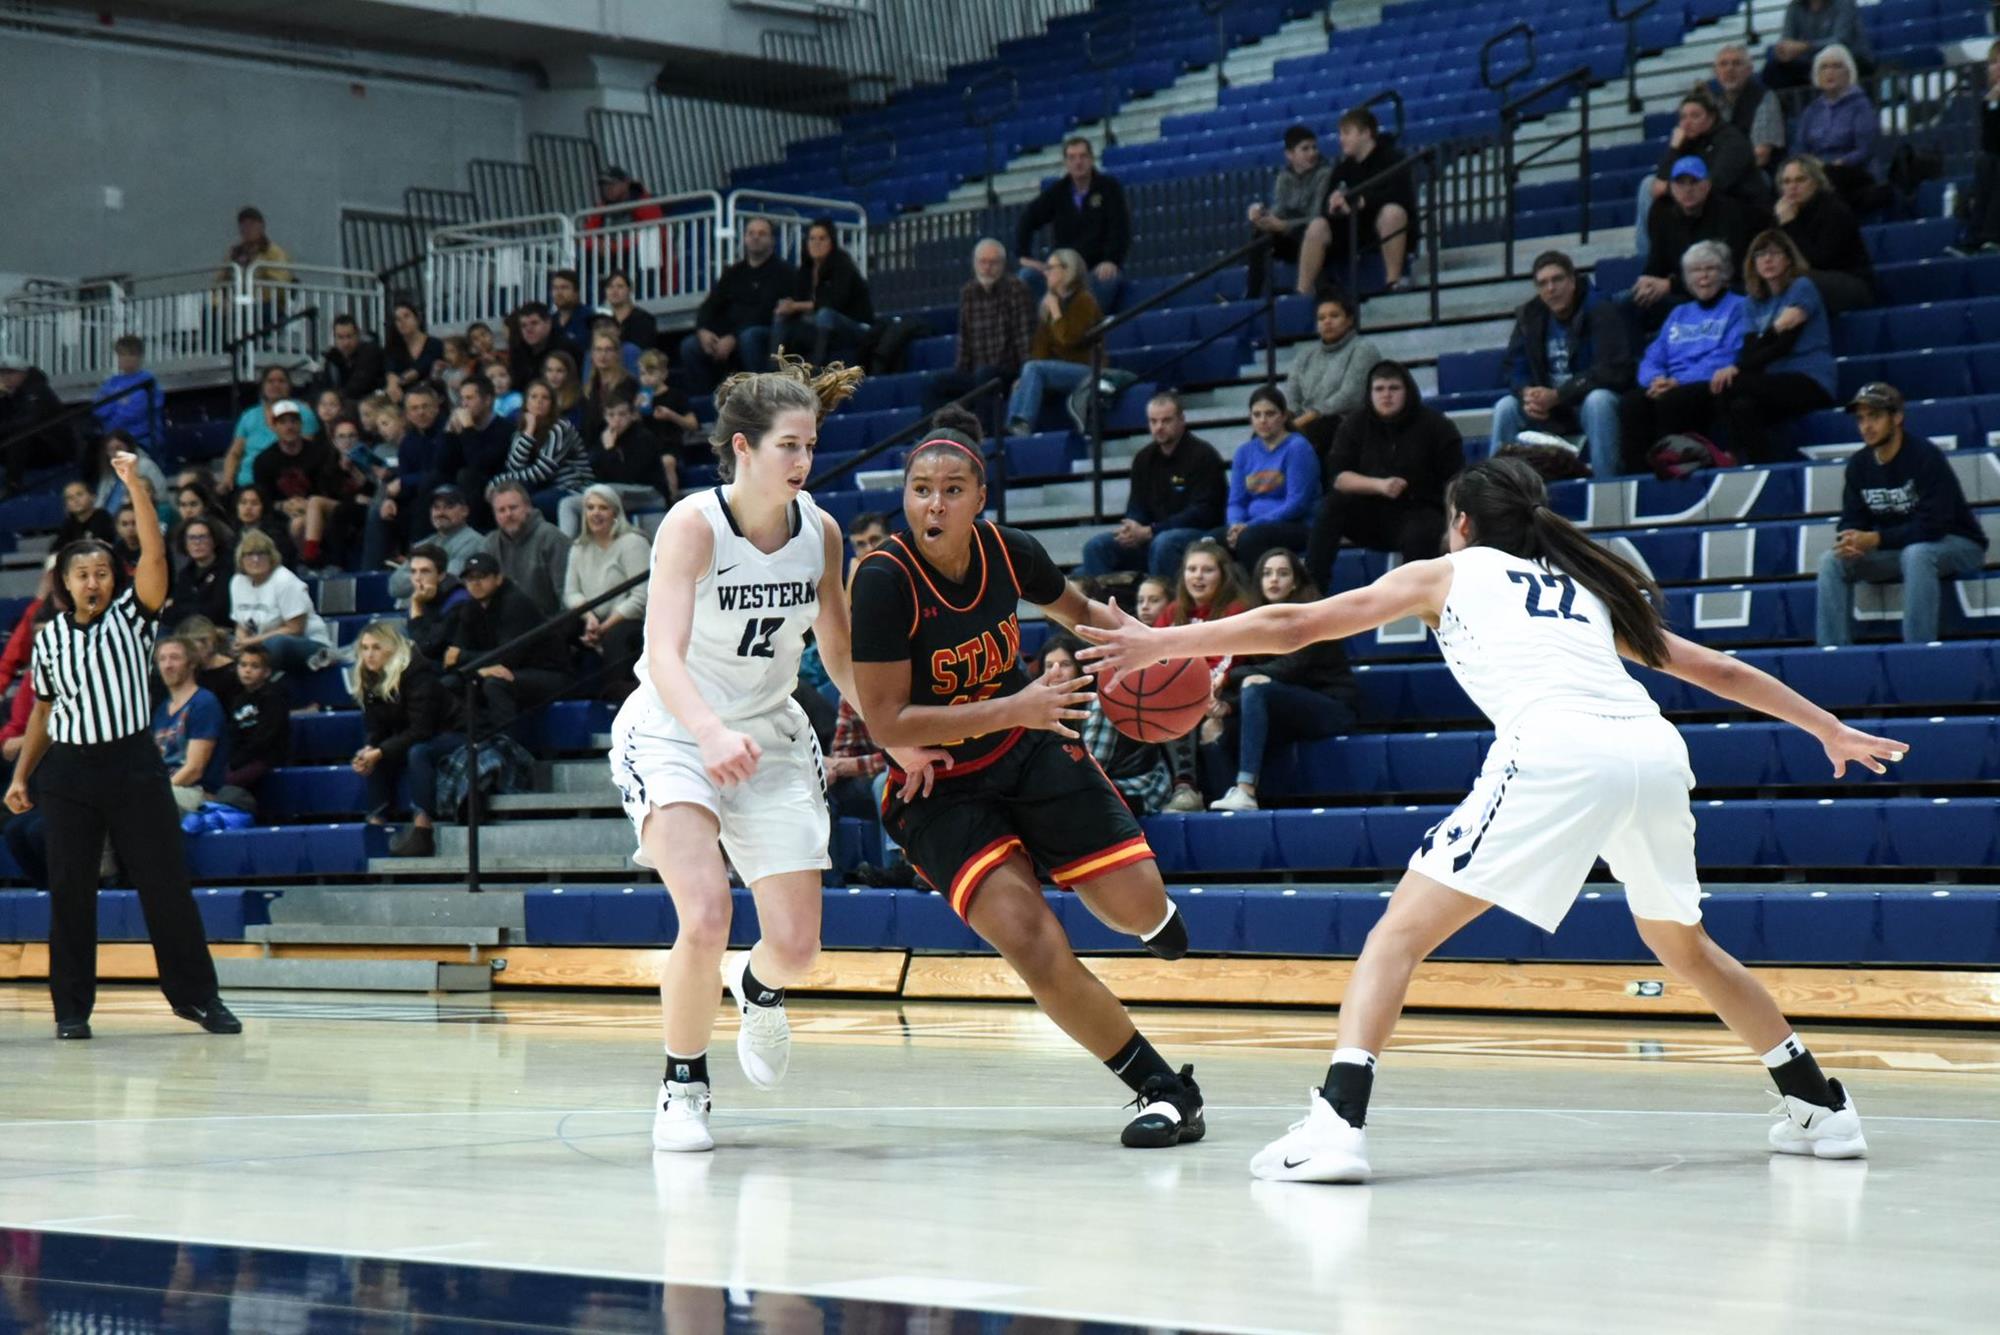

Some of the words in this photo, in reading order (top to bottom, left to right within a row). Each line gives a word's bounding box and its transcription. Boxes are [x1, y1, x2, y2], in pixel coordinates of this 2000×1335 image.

[717, 580, 816, 611] WESTERN
[1506, 569, 1591, 624] 22
[737, 617, 785, 659] 12
